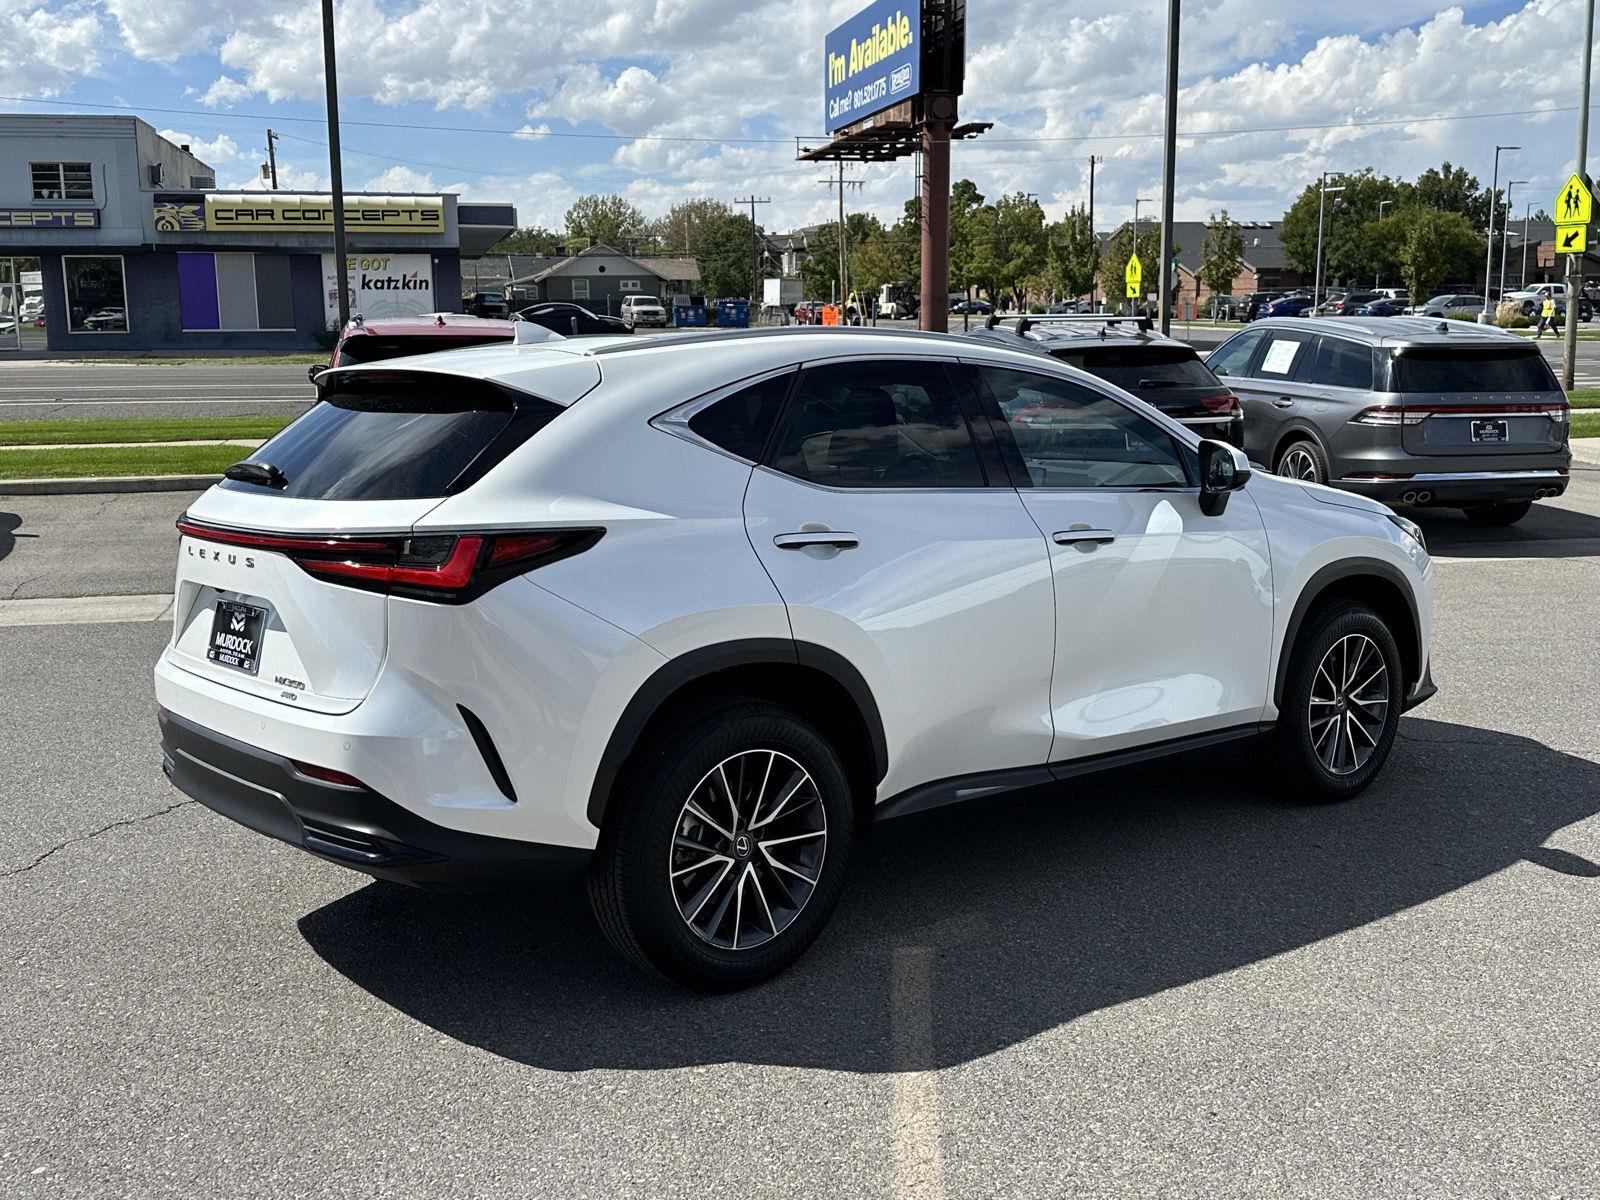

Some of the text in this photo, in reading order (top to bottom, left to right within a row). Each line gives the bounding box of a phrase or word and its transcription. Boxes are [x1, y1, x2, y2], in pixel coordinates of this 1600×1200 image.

[829, 10, 913, 88] I'm Available.
[829, 97, 840, 119] Call
[840, 90, 852, 111] me?
[214, 208, 275, 221] CAR
[361, 257, 391, 271] GOT
[361, 272, 429, 290] katzkin
[188, 546, 255, 568] LEXUS
[215, 632, 254, 655] MURDOCK
[219, 654, 240, 666] MURDOCK
